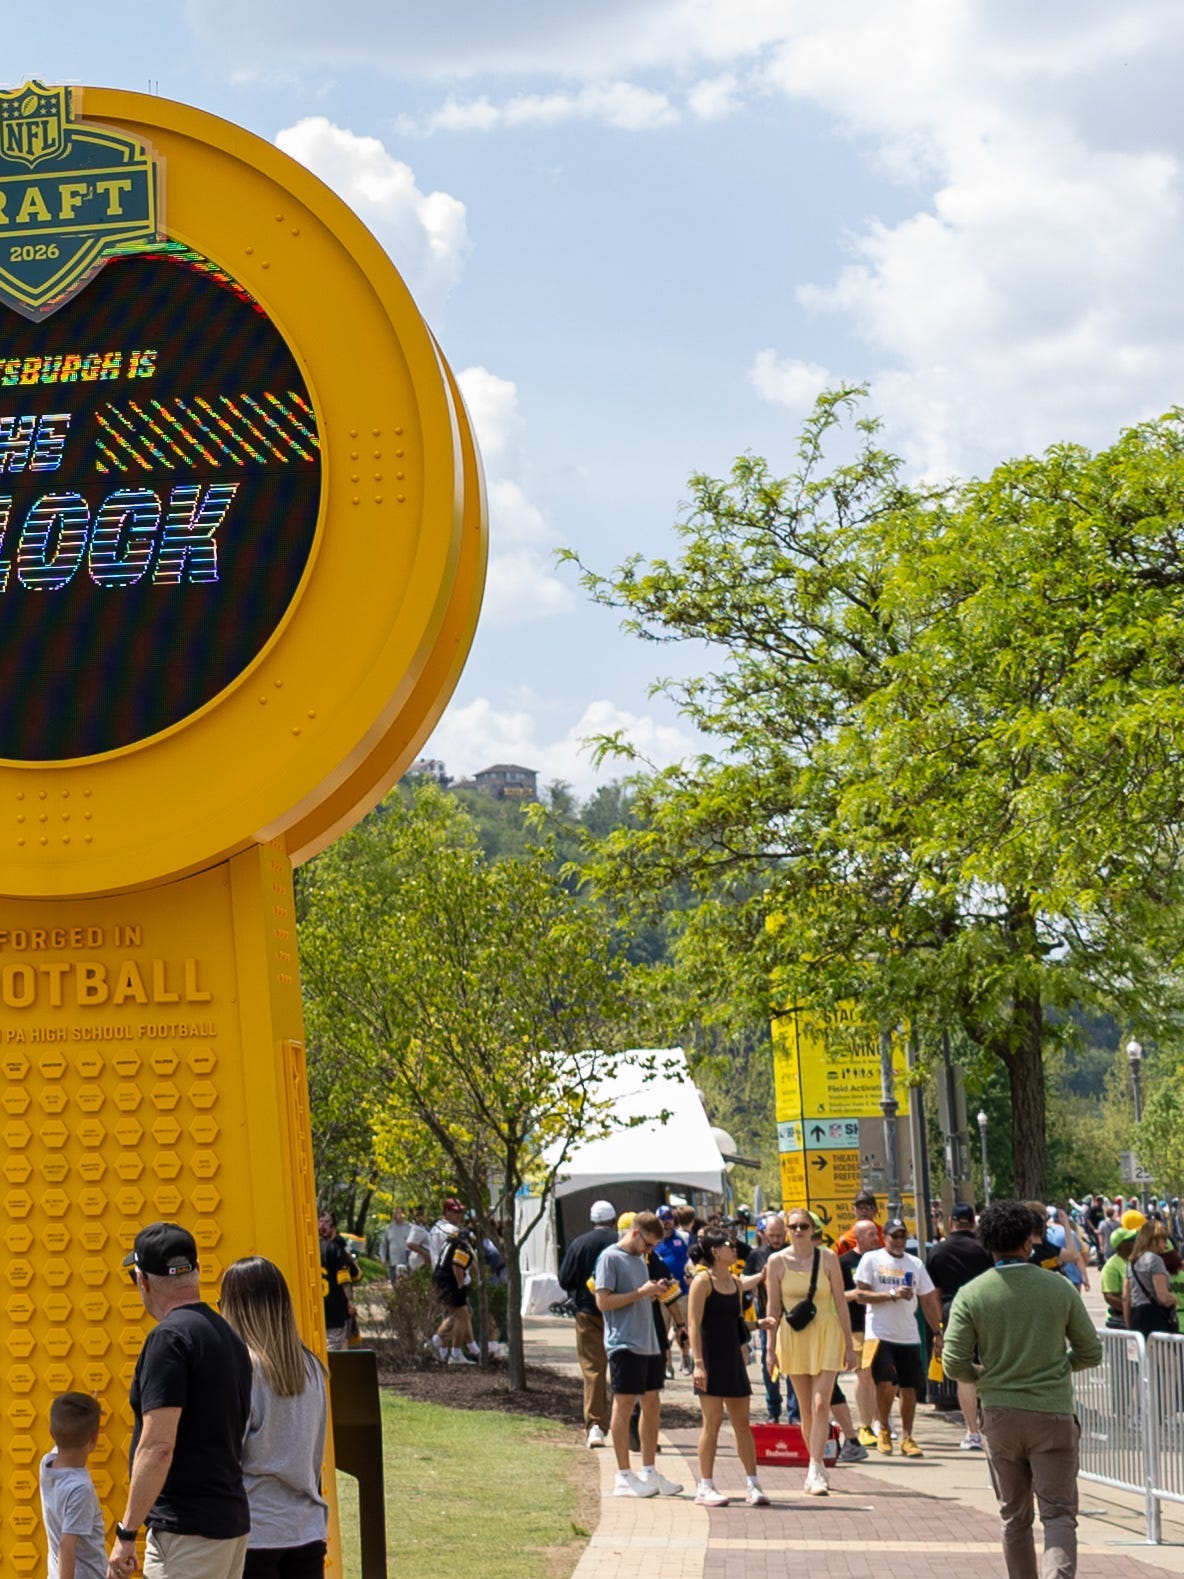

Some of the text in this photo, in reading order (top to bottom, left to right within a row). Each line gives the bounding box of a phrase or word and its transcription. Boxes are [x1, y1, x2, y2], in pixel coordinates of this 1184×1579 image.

[5, 120, 56, 155] NFL
[10, 244, 60, 262] 2026
[126, 349, 158, 379] IS
[115, 925, 143, 946] IN
[7, 1029, 25, 1043] PA
[31, 1026, 66, 1042] HIGH
[72, 1024, 133, 1041] SCHOOL
[138, 1022, 217, 1038] FOOTBALL
